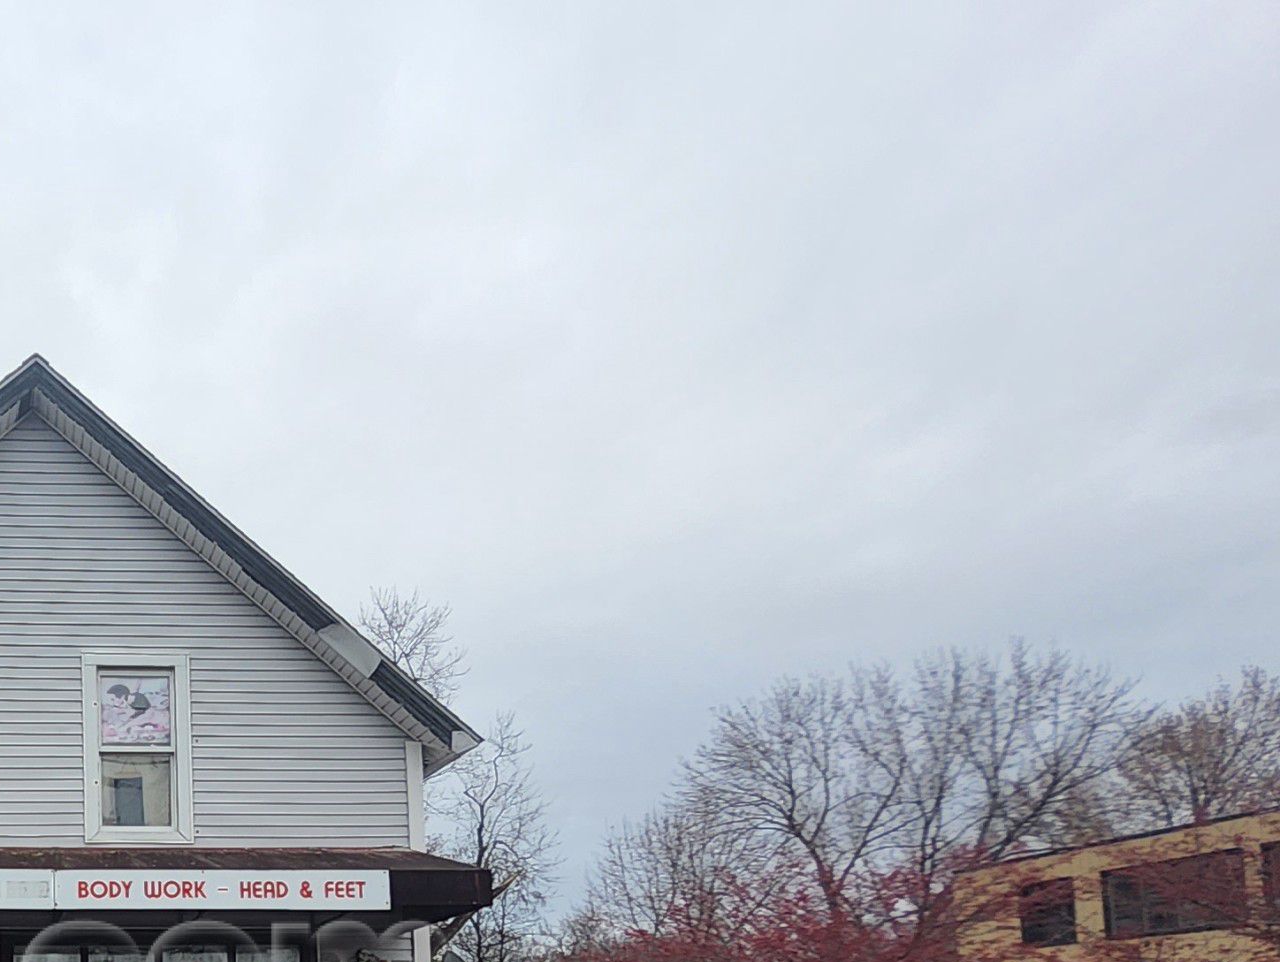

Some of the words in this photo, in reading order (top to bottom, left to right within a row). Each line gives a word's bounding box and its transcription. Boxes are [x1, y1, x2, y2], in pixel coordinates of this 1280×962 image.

[77, 880, 131, 899] BODY
[144, 881, 205, 899] WORK
[240, 881, 289, 898] HEAD
[300, 881, 313, 899] &
[324, 881, 366, 898] FEET
